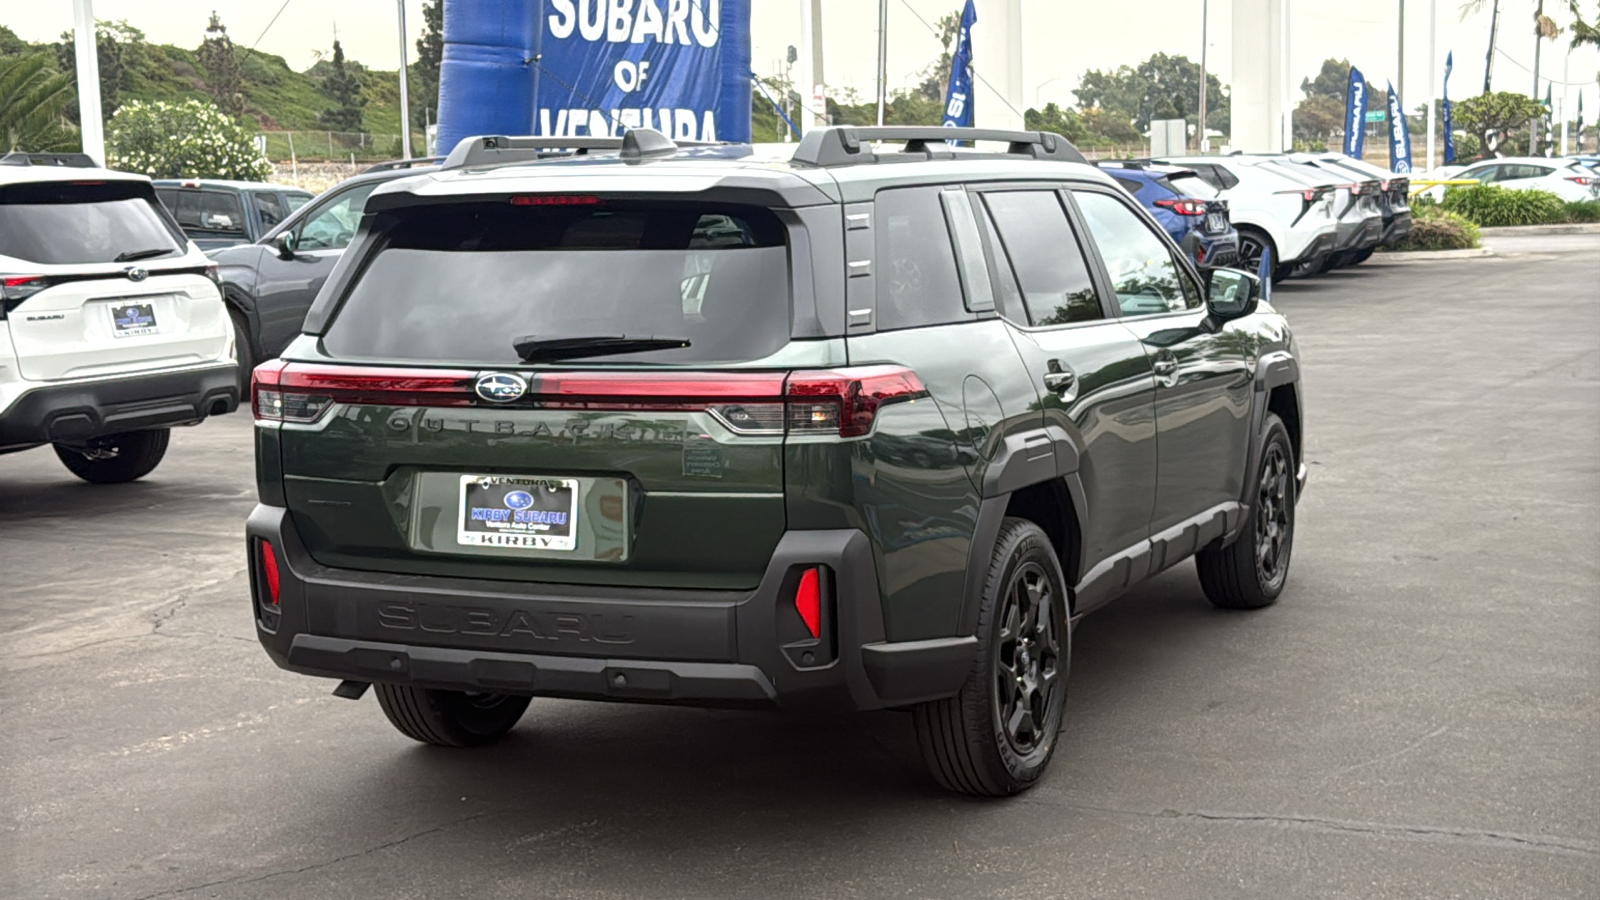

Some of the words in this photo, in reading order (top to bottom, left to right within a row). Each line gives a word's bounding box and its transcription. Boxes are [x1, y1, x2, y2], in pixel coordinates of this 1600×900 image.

[548, 0, 720, 47] SUBARU
[614, 60, 648, 92] OF
[1389, 95, 1406, 158] SUBARU
[387, 417, 631, 440] OUTBACK
[491, 477, 548, 486] VENTURA
[471, 508, 511, 520] KIRBY
[514, 511, 567, 524] SUBARU
[481, 535, 553, 546] KIRBY
[378, 604, 635, 644] SUBARU
